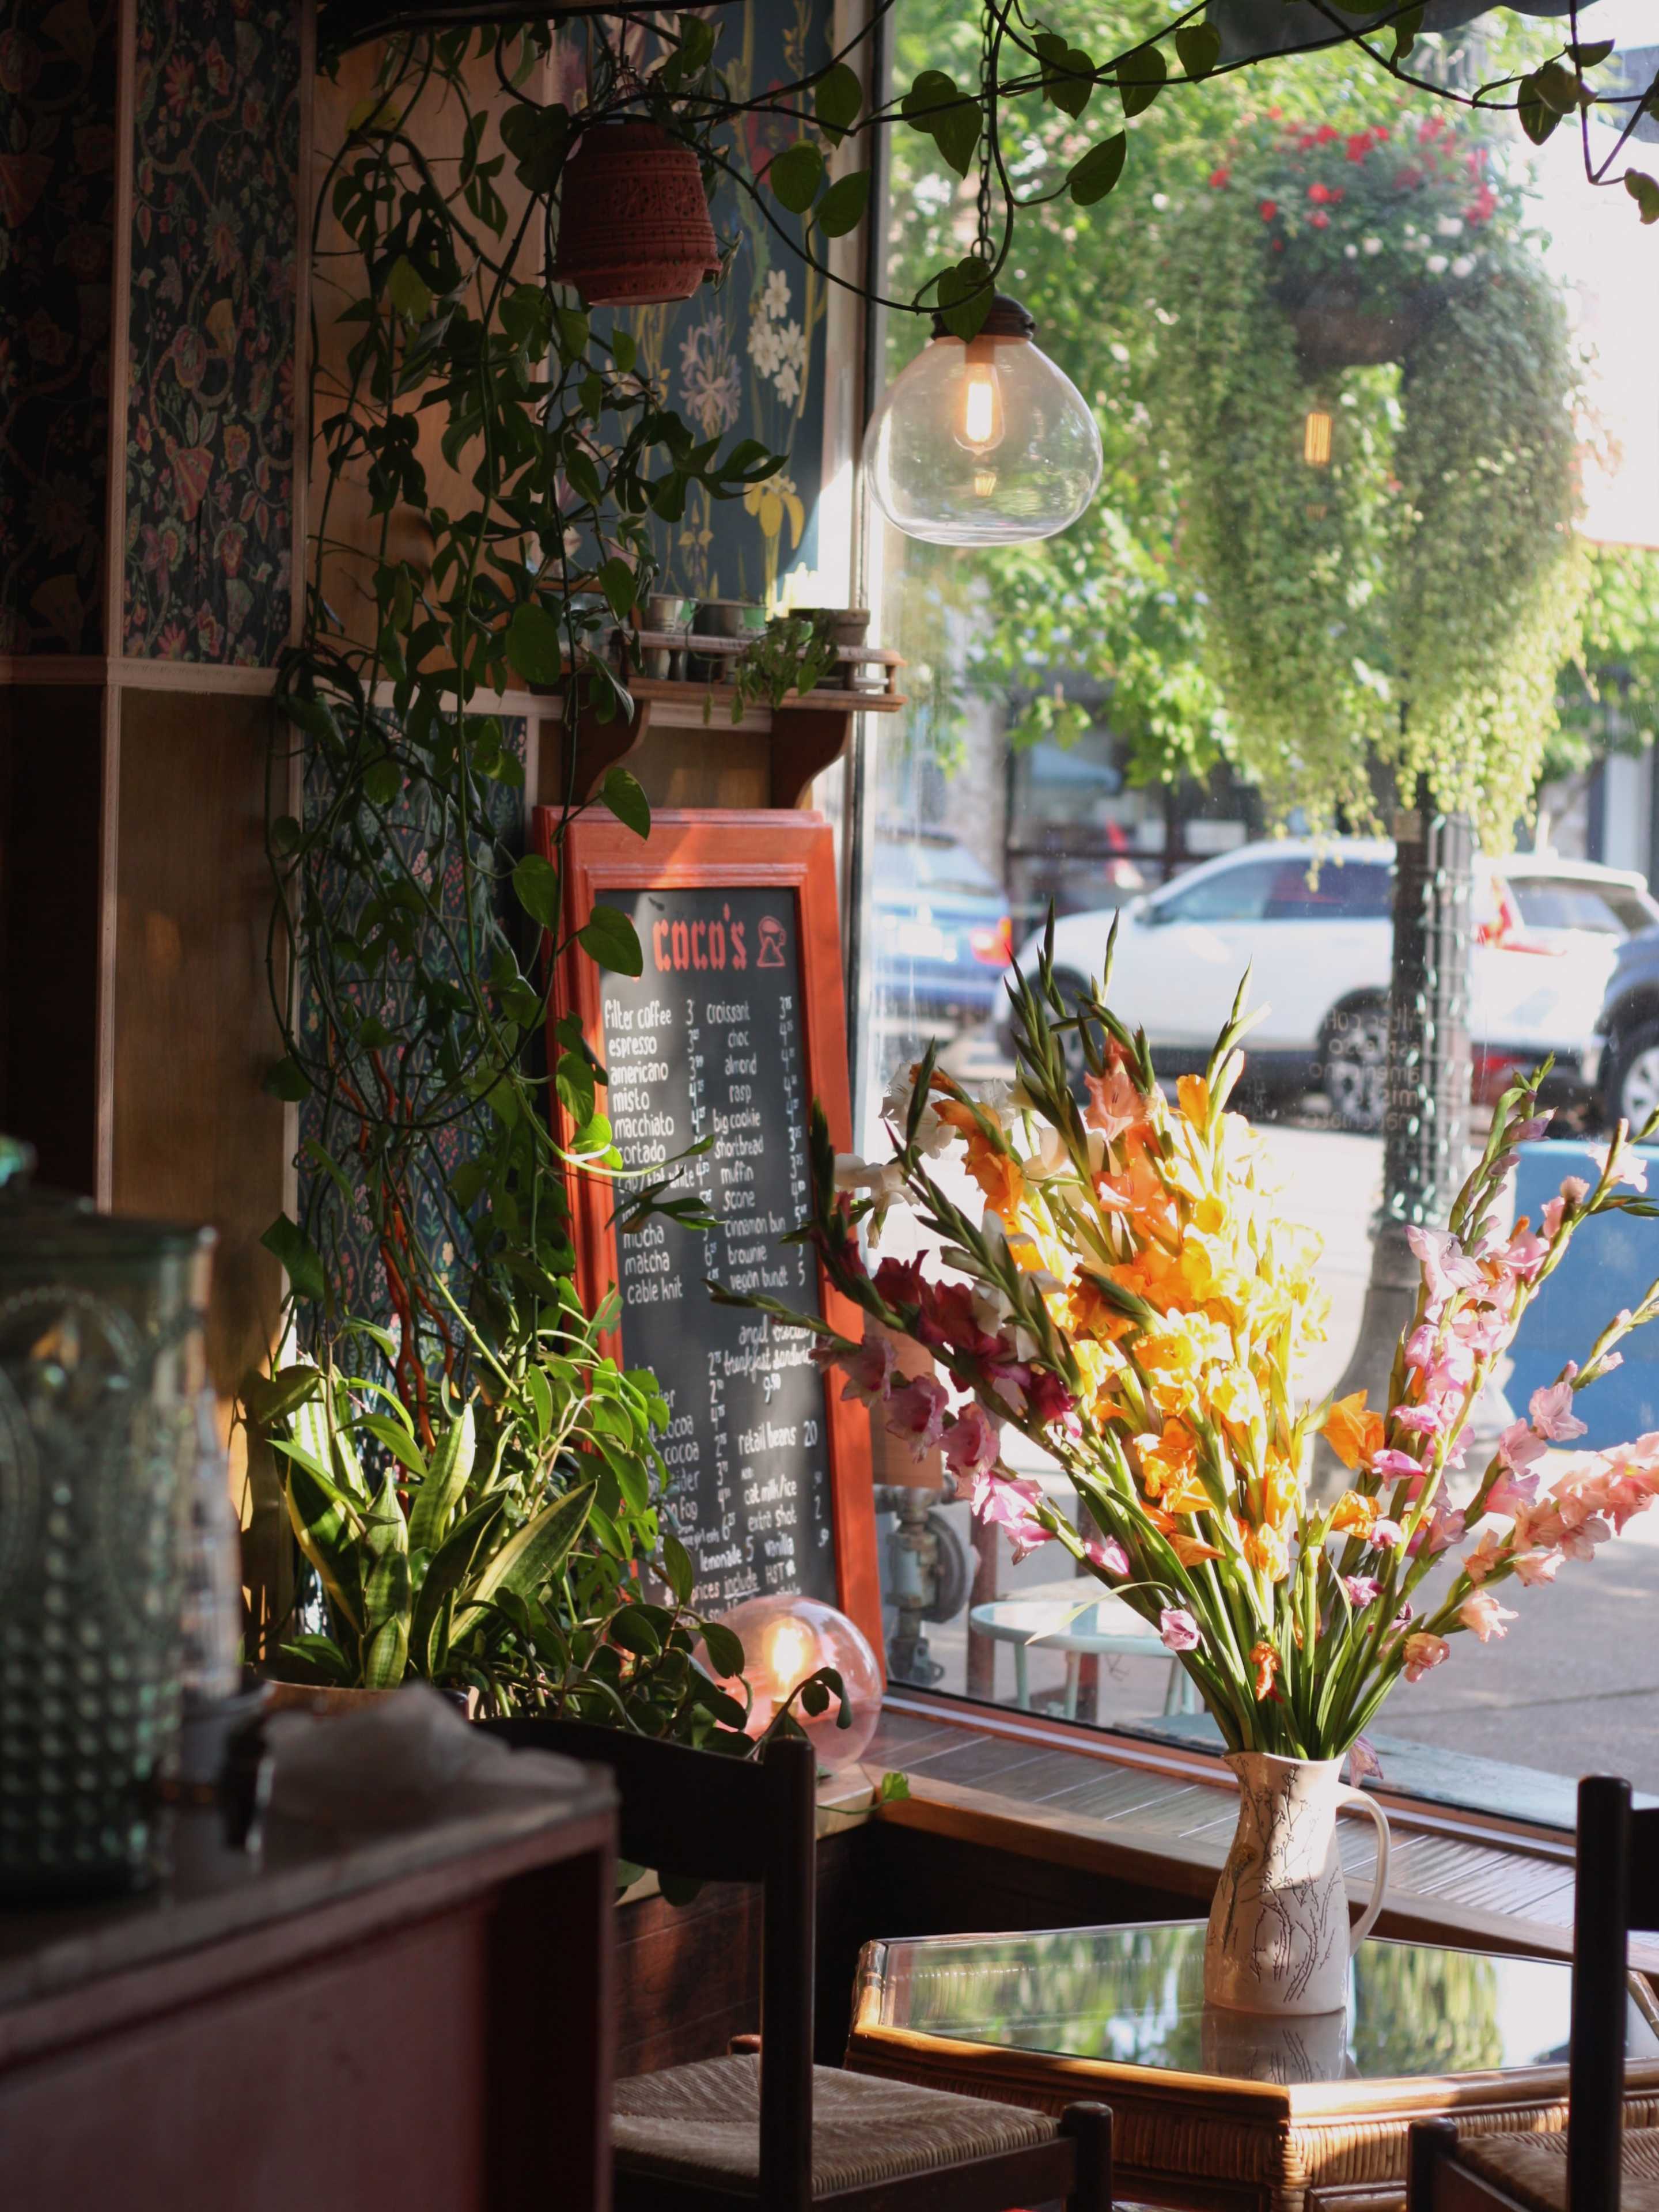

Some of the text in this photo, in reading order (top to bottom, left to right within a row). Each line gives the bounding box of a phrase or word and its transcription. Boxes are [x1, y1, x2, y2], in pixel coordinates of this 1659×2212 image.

[638, 1000, 672, 1025] coffee
[706, 1001, 751, 1024] croissant
[608, 1036, 657, 1057] espresso
[728, 1030, 749, 1048] choc
[609, 1062, 668, 1086] americano
[725, 1053, 757, 1076] almond
[613, 1088, 650, 1112] misto
[729, 1084, 752, 1105] rasp
[615, 1111, 674, 1139] macchiato
[713, 1108, 729, 1135] big
[730, 1109, 760, 1128] cookie
[714, 1135, 764, 1159] shortbread
[721, 1161, 754, 1185] muffin
[723, 1191, 755, 1211] scone
[725, 1218, 767, 1238] cinnamon
[769, 1211, 786, 1233] bun
[625, 1251, 670, 1276] matcha
[728, 1243, 767, 1265] brownie
[627, 1280, 658, 1305] cable
[661, 1274, 683, 1300] knit
[730, 1271, 759, 1294] vegan
[762, 1266, 788, 1288] bundt
[724, 1347, 772, 1383] breakfast
[738, 1420, 818, 1456] retail beans 20
[664, 1441, 700, 1466] cocoa
[764, 1531, 795, 1558] vanilla
[699, 1544, 743, 1572] lemonade
[691, 1579, 720, 1604] prices
[724, 1566, 759, 1594] include
[765, 1562, 784, 1585] HST
